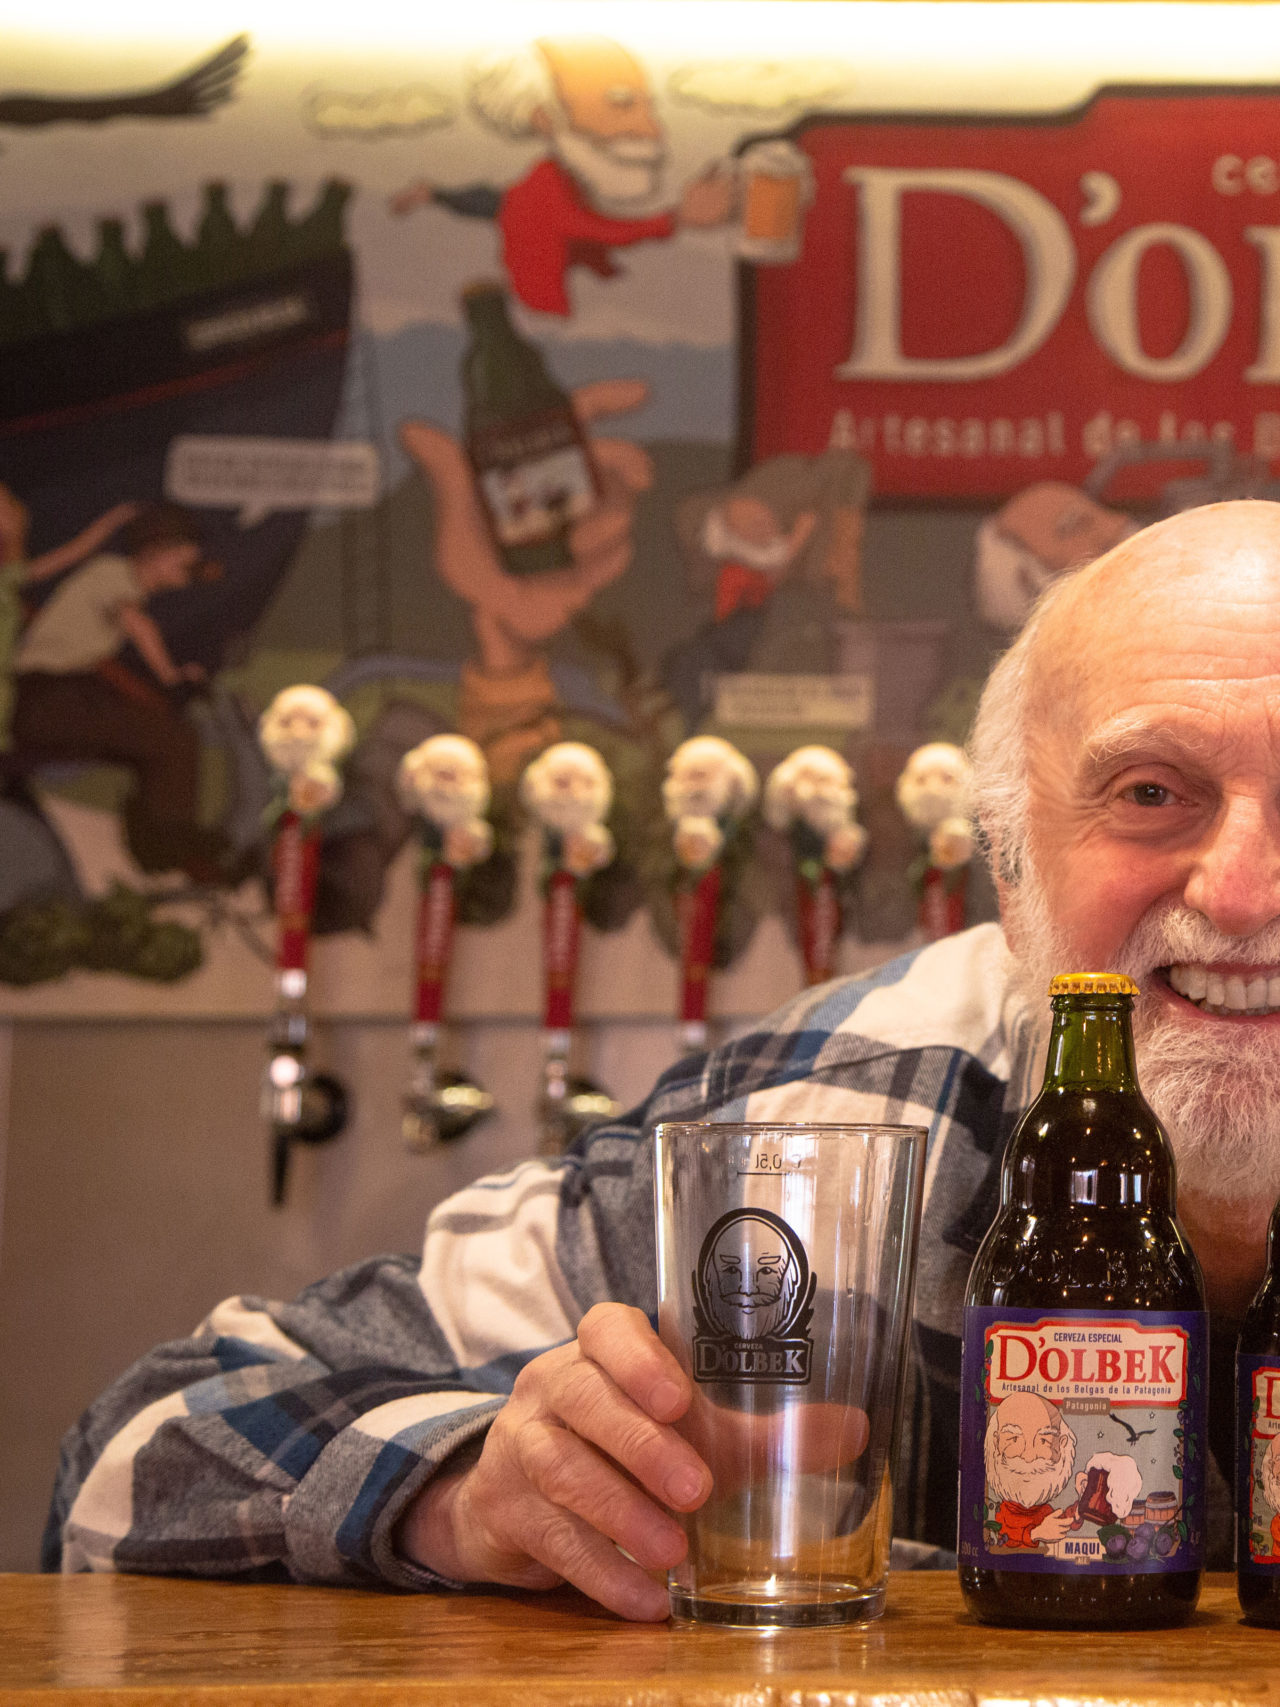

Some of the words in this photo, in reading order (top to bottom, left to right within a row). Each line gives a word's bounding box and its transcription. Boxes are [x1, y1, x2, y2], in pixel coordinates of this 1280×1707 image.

[828, 408, 1066, 459] Artesanal
[1083, 408, 1142, 458] de
[1054, 1332, 1086, 1343] CERVEZA
[1088, 1333, 1123, 1343] ESPECIAL
[734, 1342, 764, 1350] CERVEZA
[698, 1343, 805, 1373] D'OLBEK
[996, 1334, 1176, 1383] D'OLBEK
[1001, 1382, 1039, 1393] Artesanal
[1043, 1384, 1053, 1393] de
[1056, 1384, 1070, 1393] los
[1074, 1385, 1104, 1395] Belgas
[1108, 1385, 1119, 1394] de
[1122, 1385, 1131, 1394] la
[1134, 1386, 1171, 1397] Patagonia
[1065, 1401, 1107, 1412] Patagonia
[1064, 1541, 1100, 1557] MAQUI
